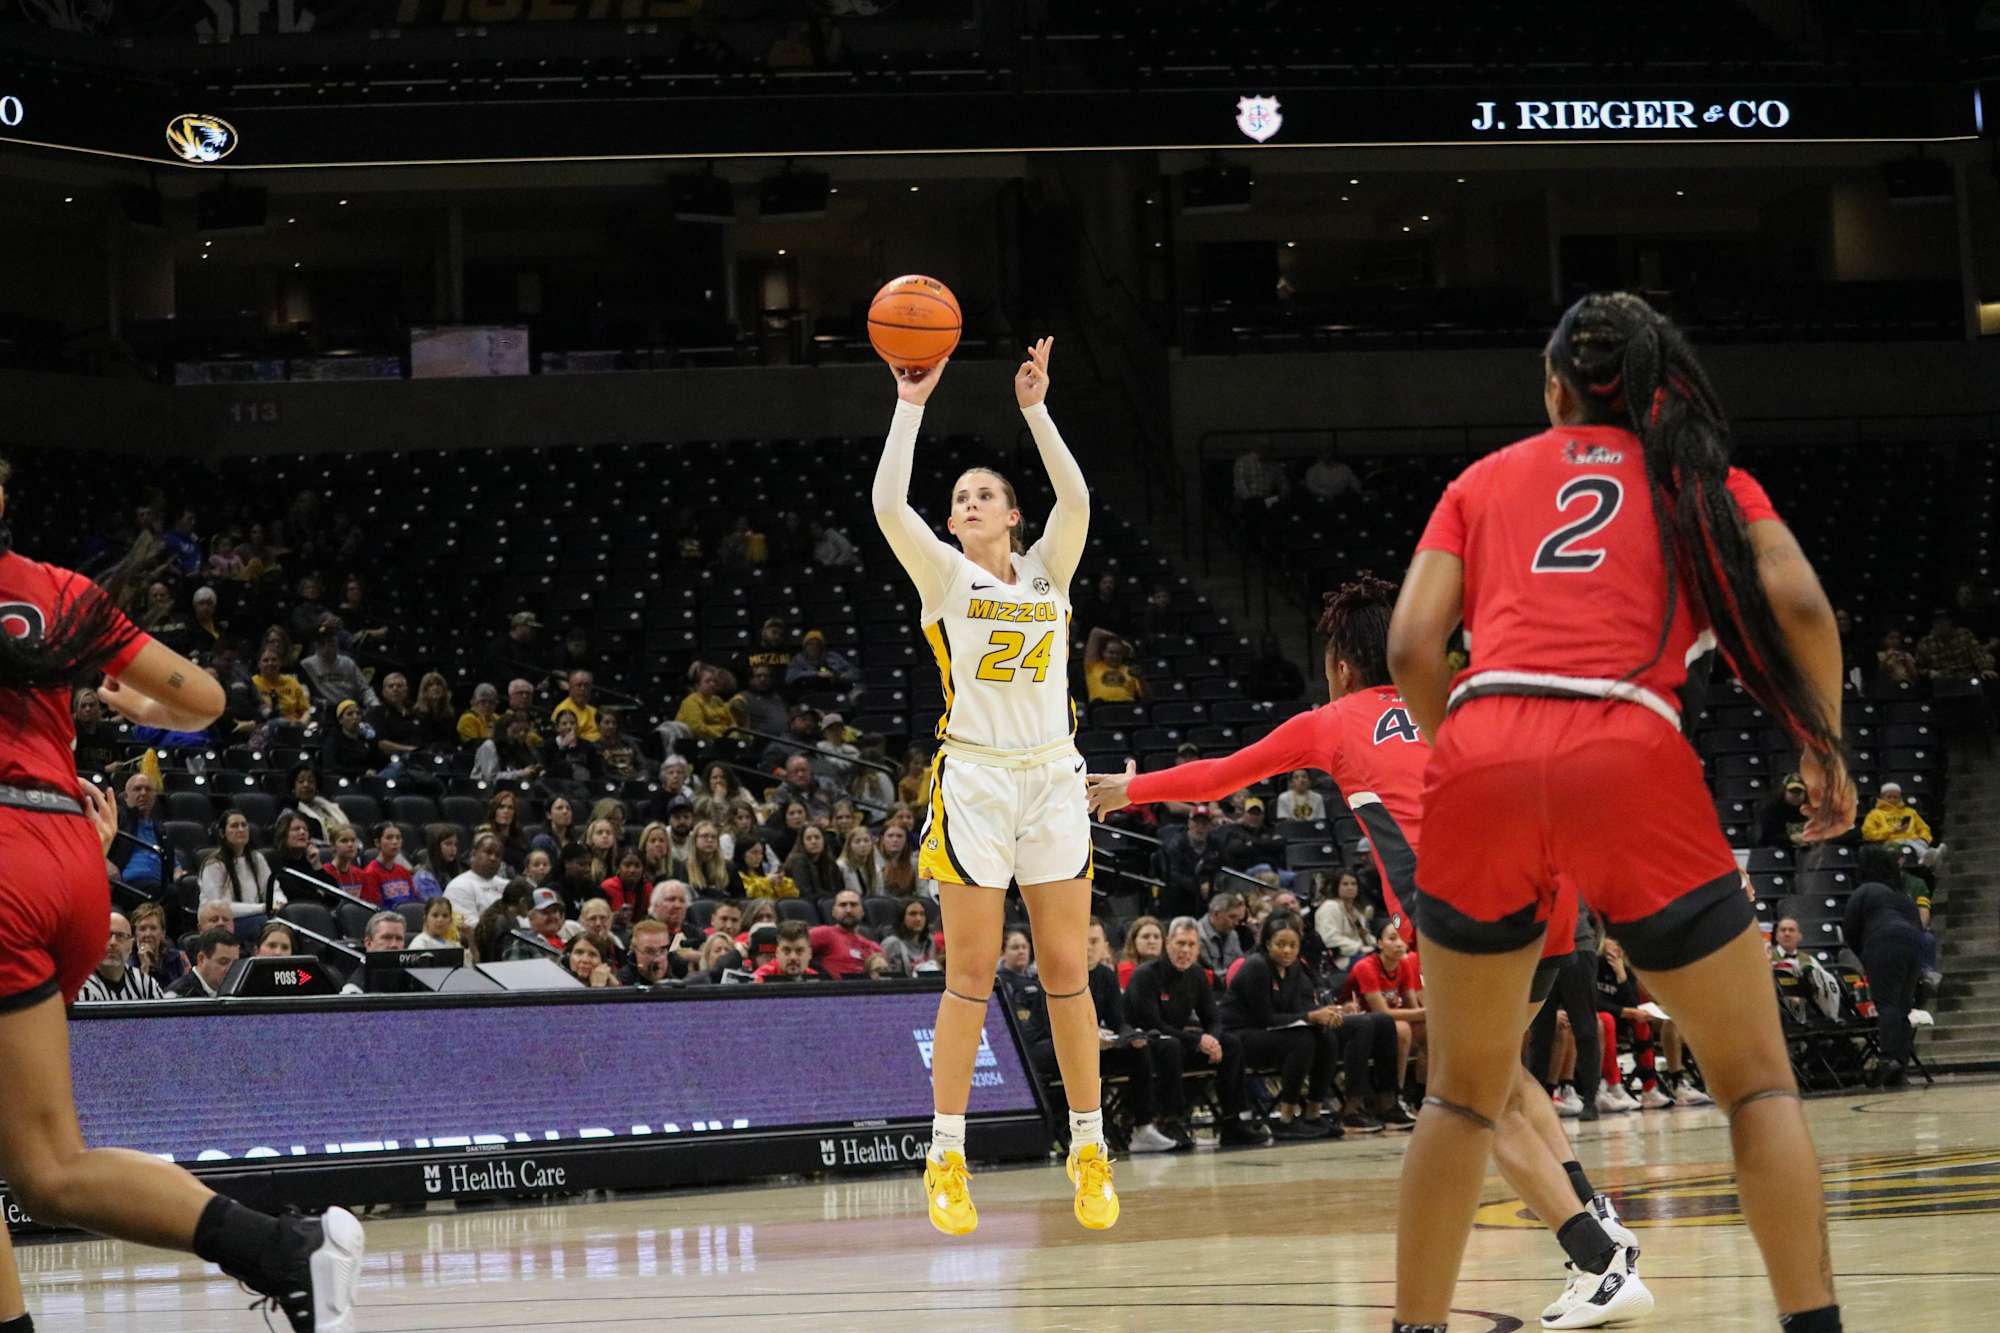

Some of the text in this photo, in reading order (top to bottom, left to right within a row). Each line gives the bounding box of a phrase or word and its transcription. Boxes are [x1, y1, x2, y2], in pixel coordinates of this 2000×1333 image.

[1471, 99, 1790, 130] J. RIEGER & CO
[229, 402, 280, 422] 113
[1530, 474, 1624, 573] 2
[966, 598, 1058, 623] MIZZOU
[975, 630, 1055, 683] 24
[1373, 707, 1420, 746] 4
[274, 970, 297, 985] POSS
[840, 1135, 900, 1165] Health
[901, 1134, 931, 1161] Car
[448, 1160, 517, 1193] Health
[520, 1159, 566, 1188] Care
